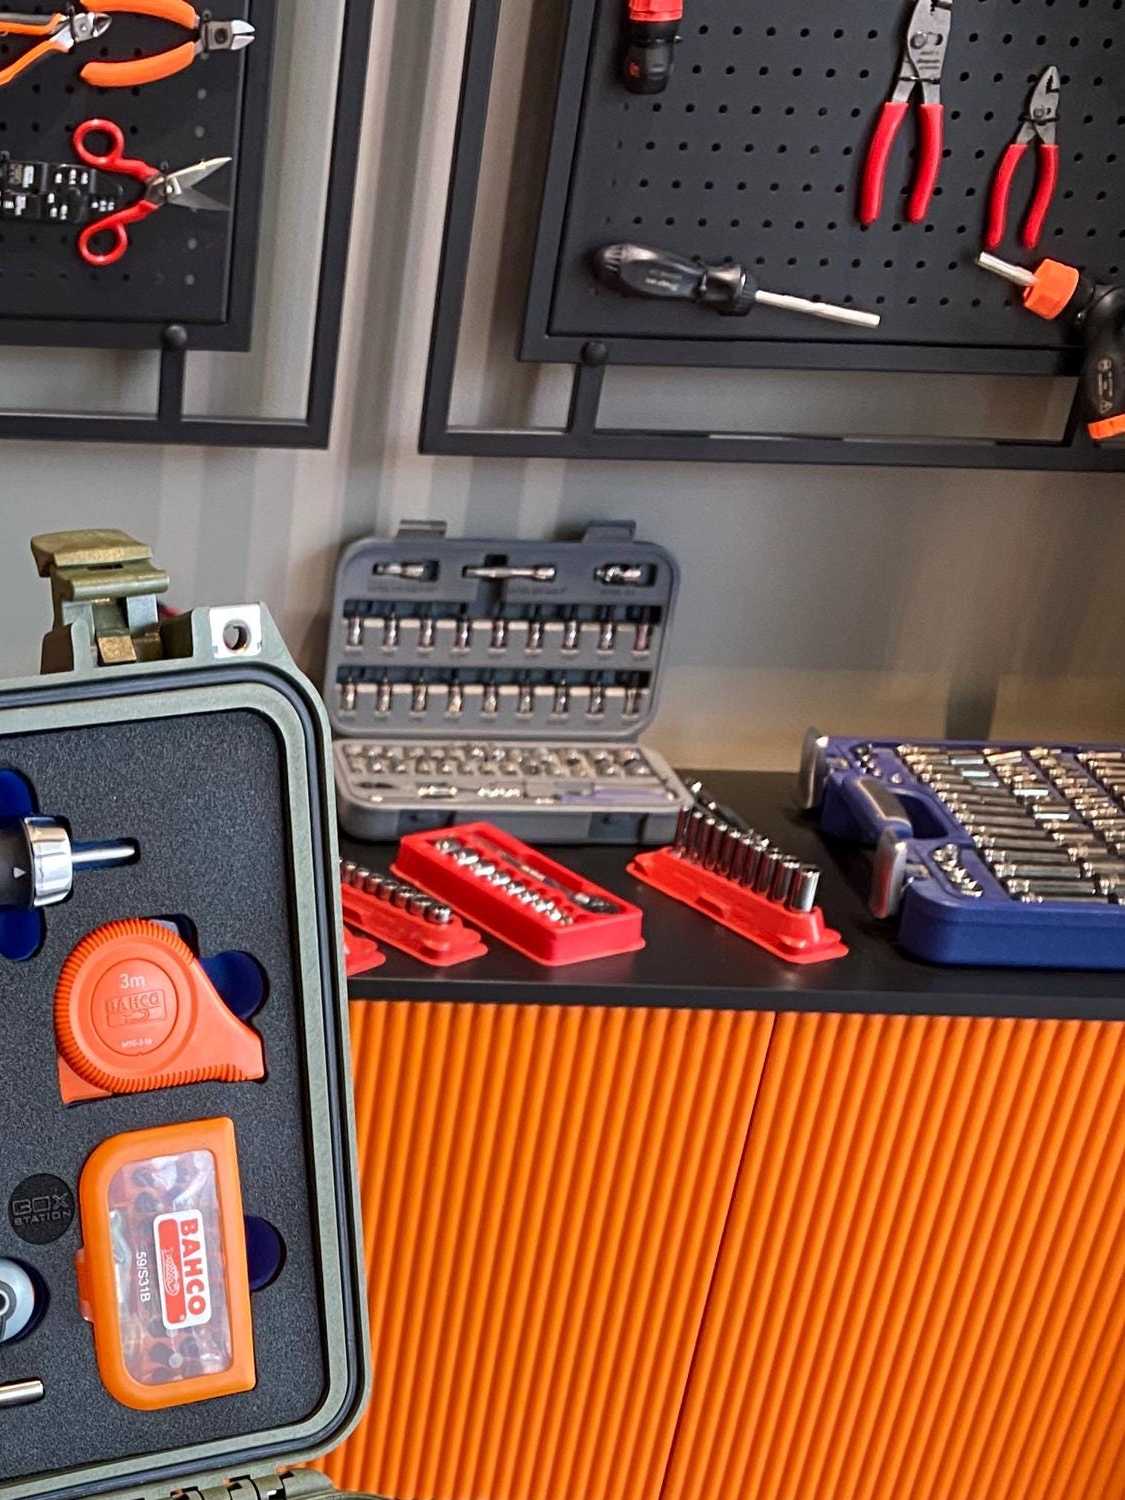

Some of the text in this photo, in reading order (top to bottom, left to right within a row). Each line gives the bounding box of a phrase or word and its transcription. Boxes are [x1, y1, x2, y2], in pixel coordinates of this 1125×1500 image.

[119, 972, 146, 990] 3m
[106, 992, 160, 1012] BAHCO
[11, 1193, 70, 1216] BOX
[14, 1209, 72, 1226] STATION
[135, 1251, 151, 1303] 59/S31B
[180, 1218, 207, 1316] BAHCO
